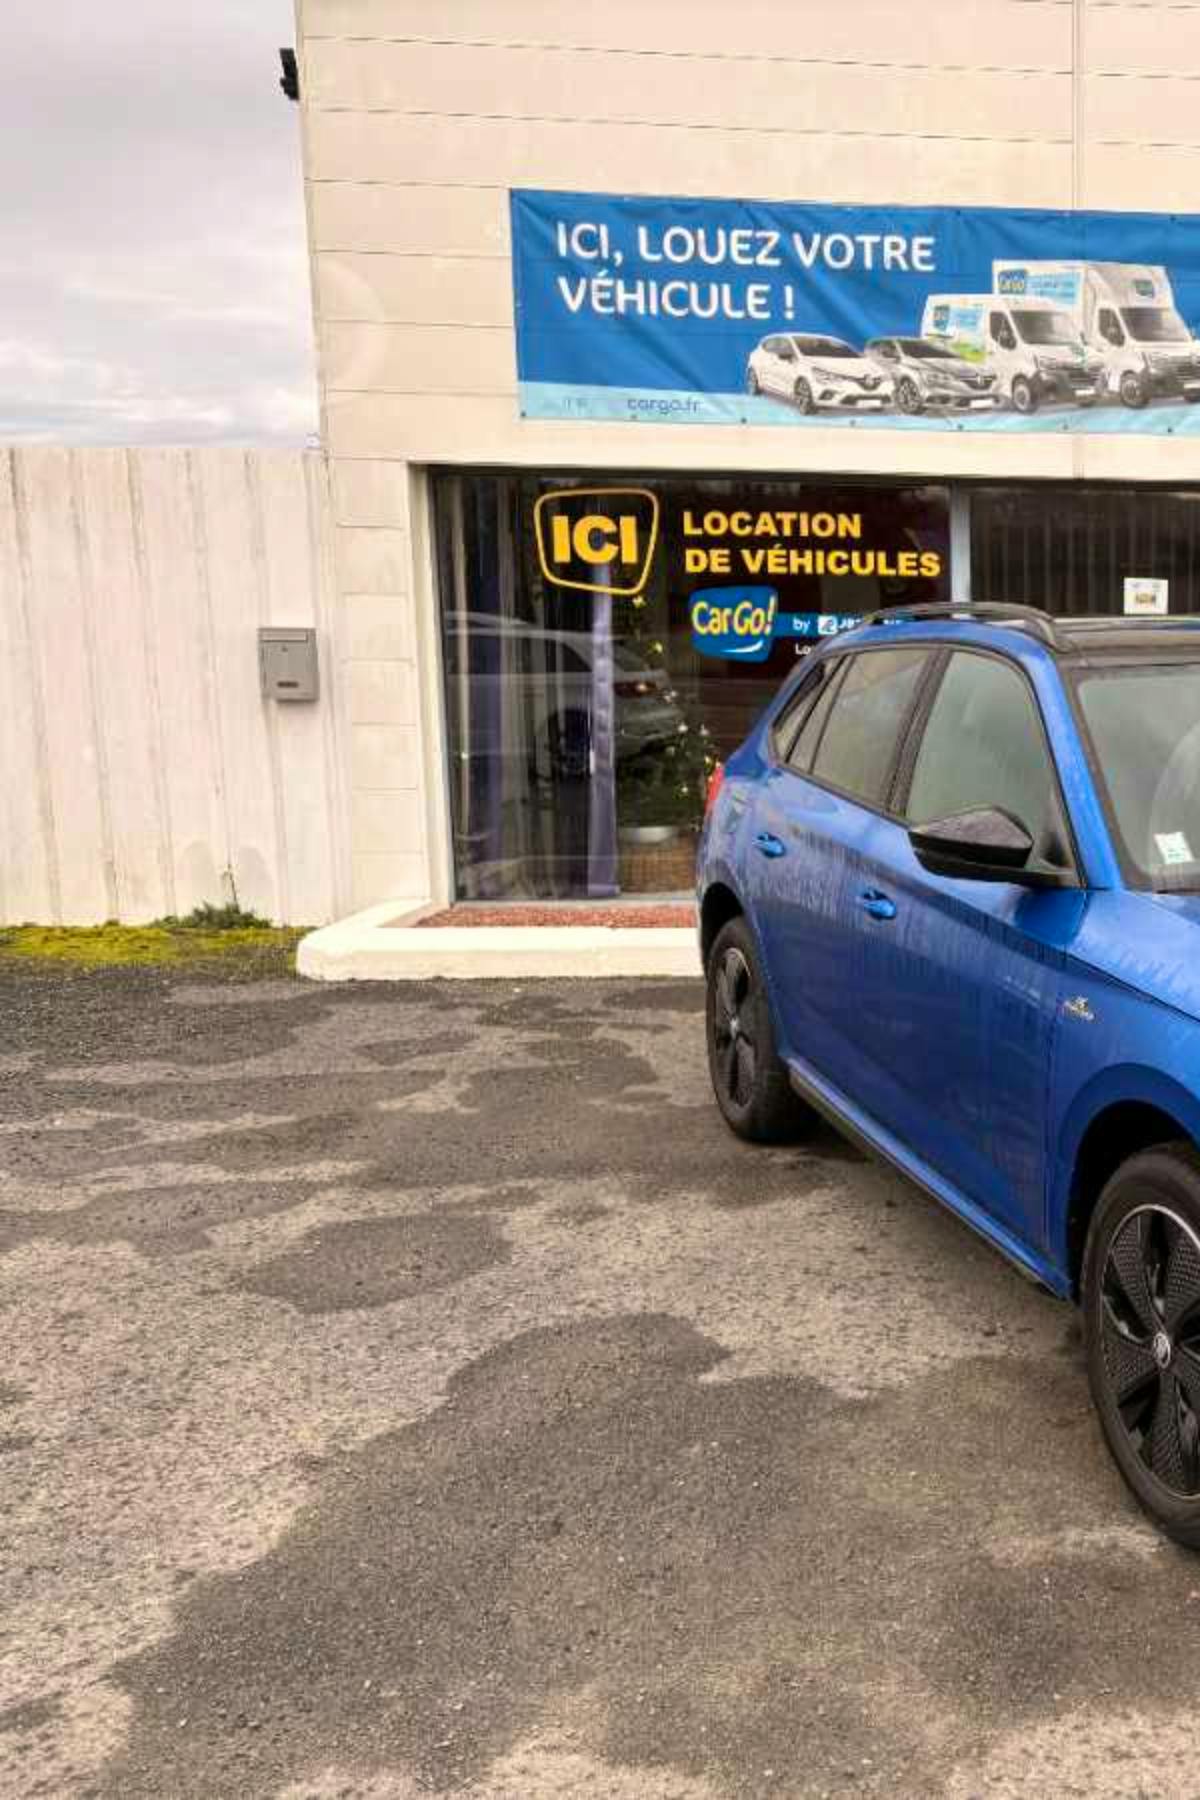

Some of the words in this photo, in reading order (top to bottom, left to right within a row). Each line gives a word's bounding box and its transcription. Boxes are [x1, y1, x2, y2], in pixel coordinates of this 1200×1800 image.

[556, 221, 624, 266] ICI,
[637, 225, 782, 267] LOUEZ
[793, 233, 937, 272] VOTRE
[556, 268, 773, 320] VÉHICULE
[783, 284, 796, 321] !
[626, 397, 703, 415] cargo.fr
[552, 514, 638, 565] ICI
[682, 510, 862, 538] LOCATION
[684, 548, 732, 574] DE
[740, 543, 942, 577] VÉHICULES
[690, 595, 777, 636] CarGo!
[792, 616, 812, 634] by
